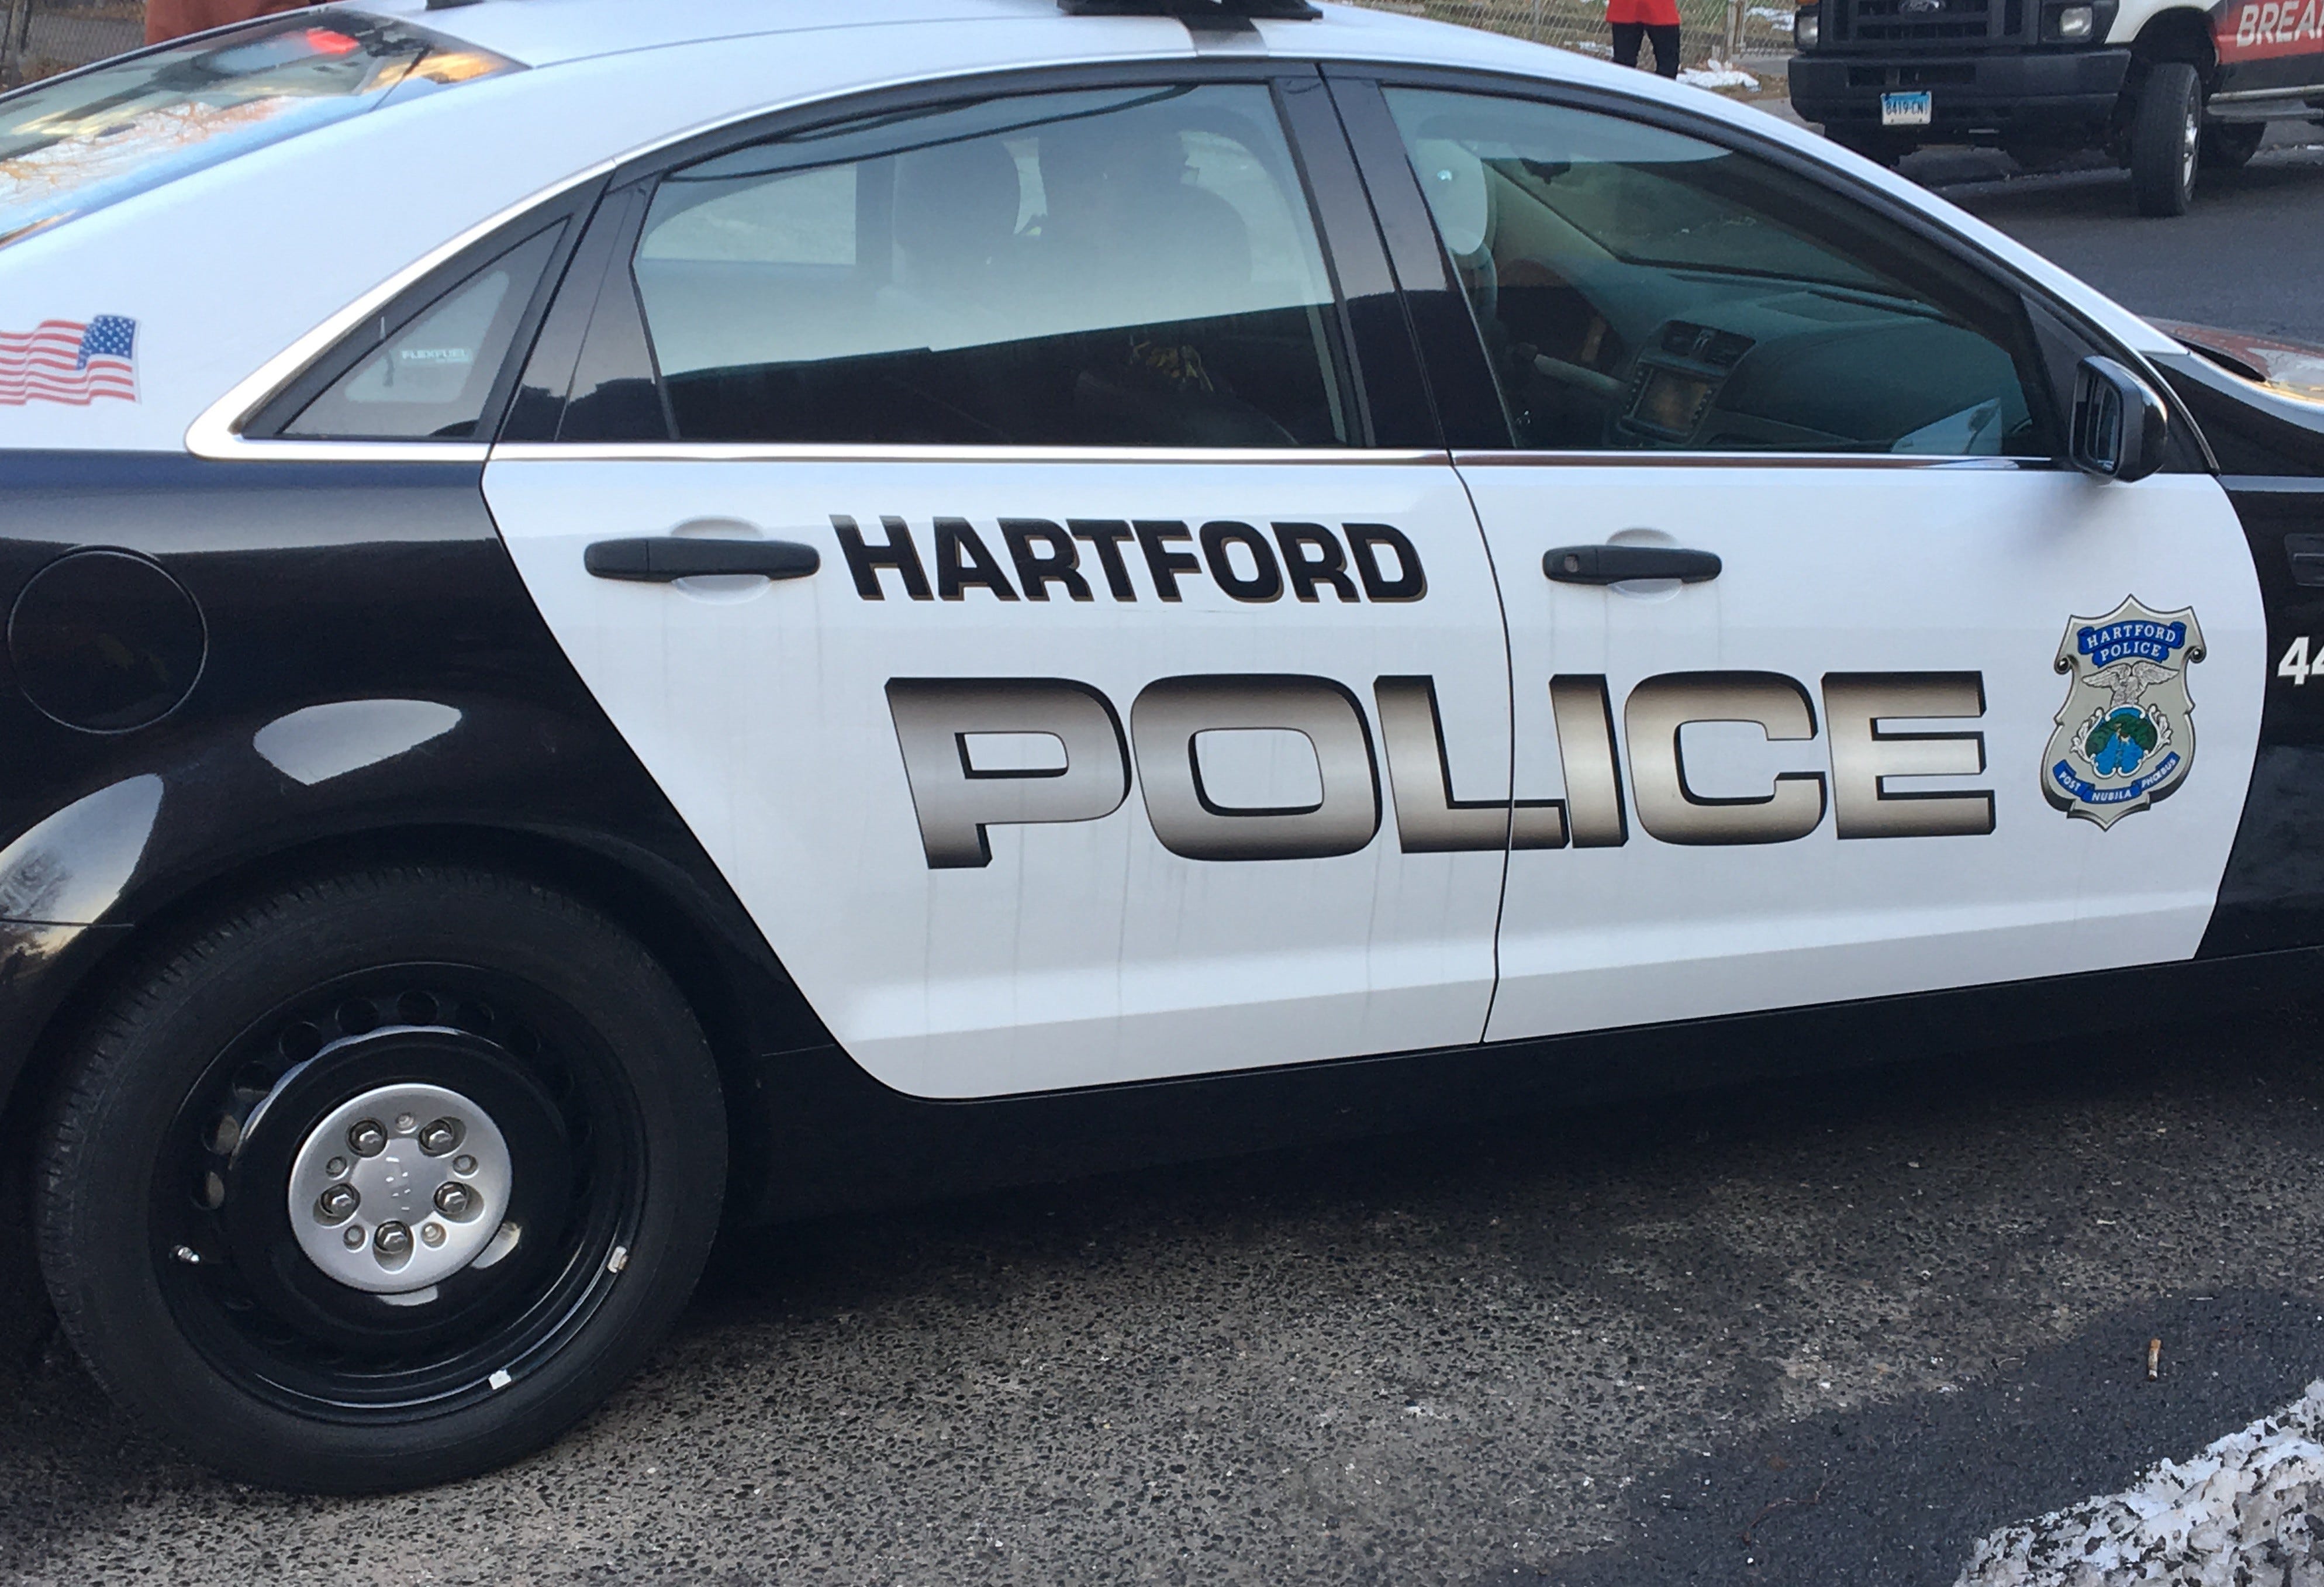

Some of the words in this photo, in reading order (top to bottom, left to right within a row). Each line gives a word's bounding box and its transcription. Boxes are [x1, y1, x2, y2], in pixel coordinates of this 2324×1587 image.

[828, 514, 1428, 603] HARTFORD
[2087, 624, 2175, 649] HARTFORD
[2100, 641, 2161, 661] POLICE
[883, 670, 1996, 870] POLICE
[2058, 771, 2081, 792] POST
[2091, 789, 2132, 802] NUBILA
